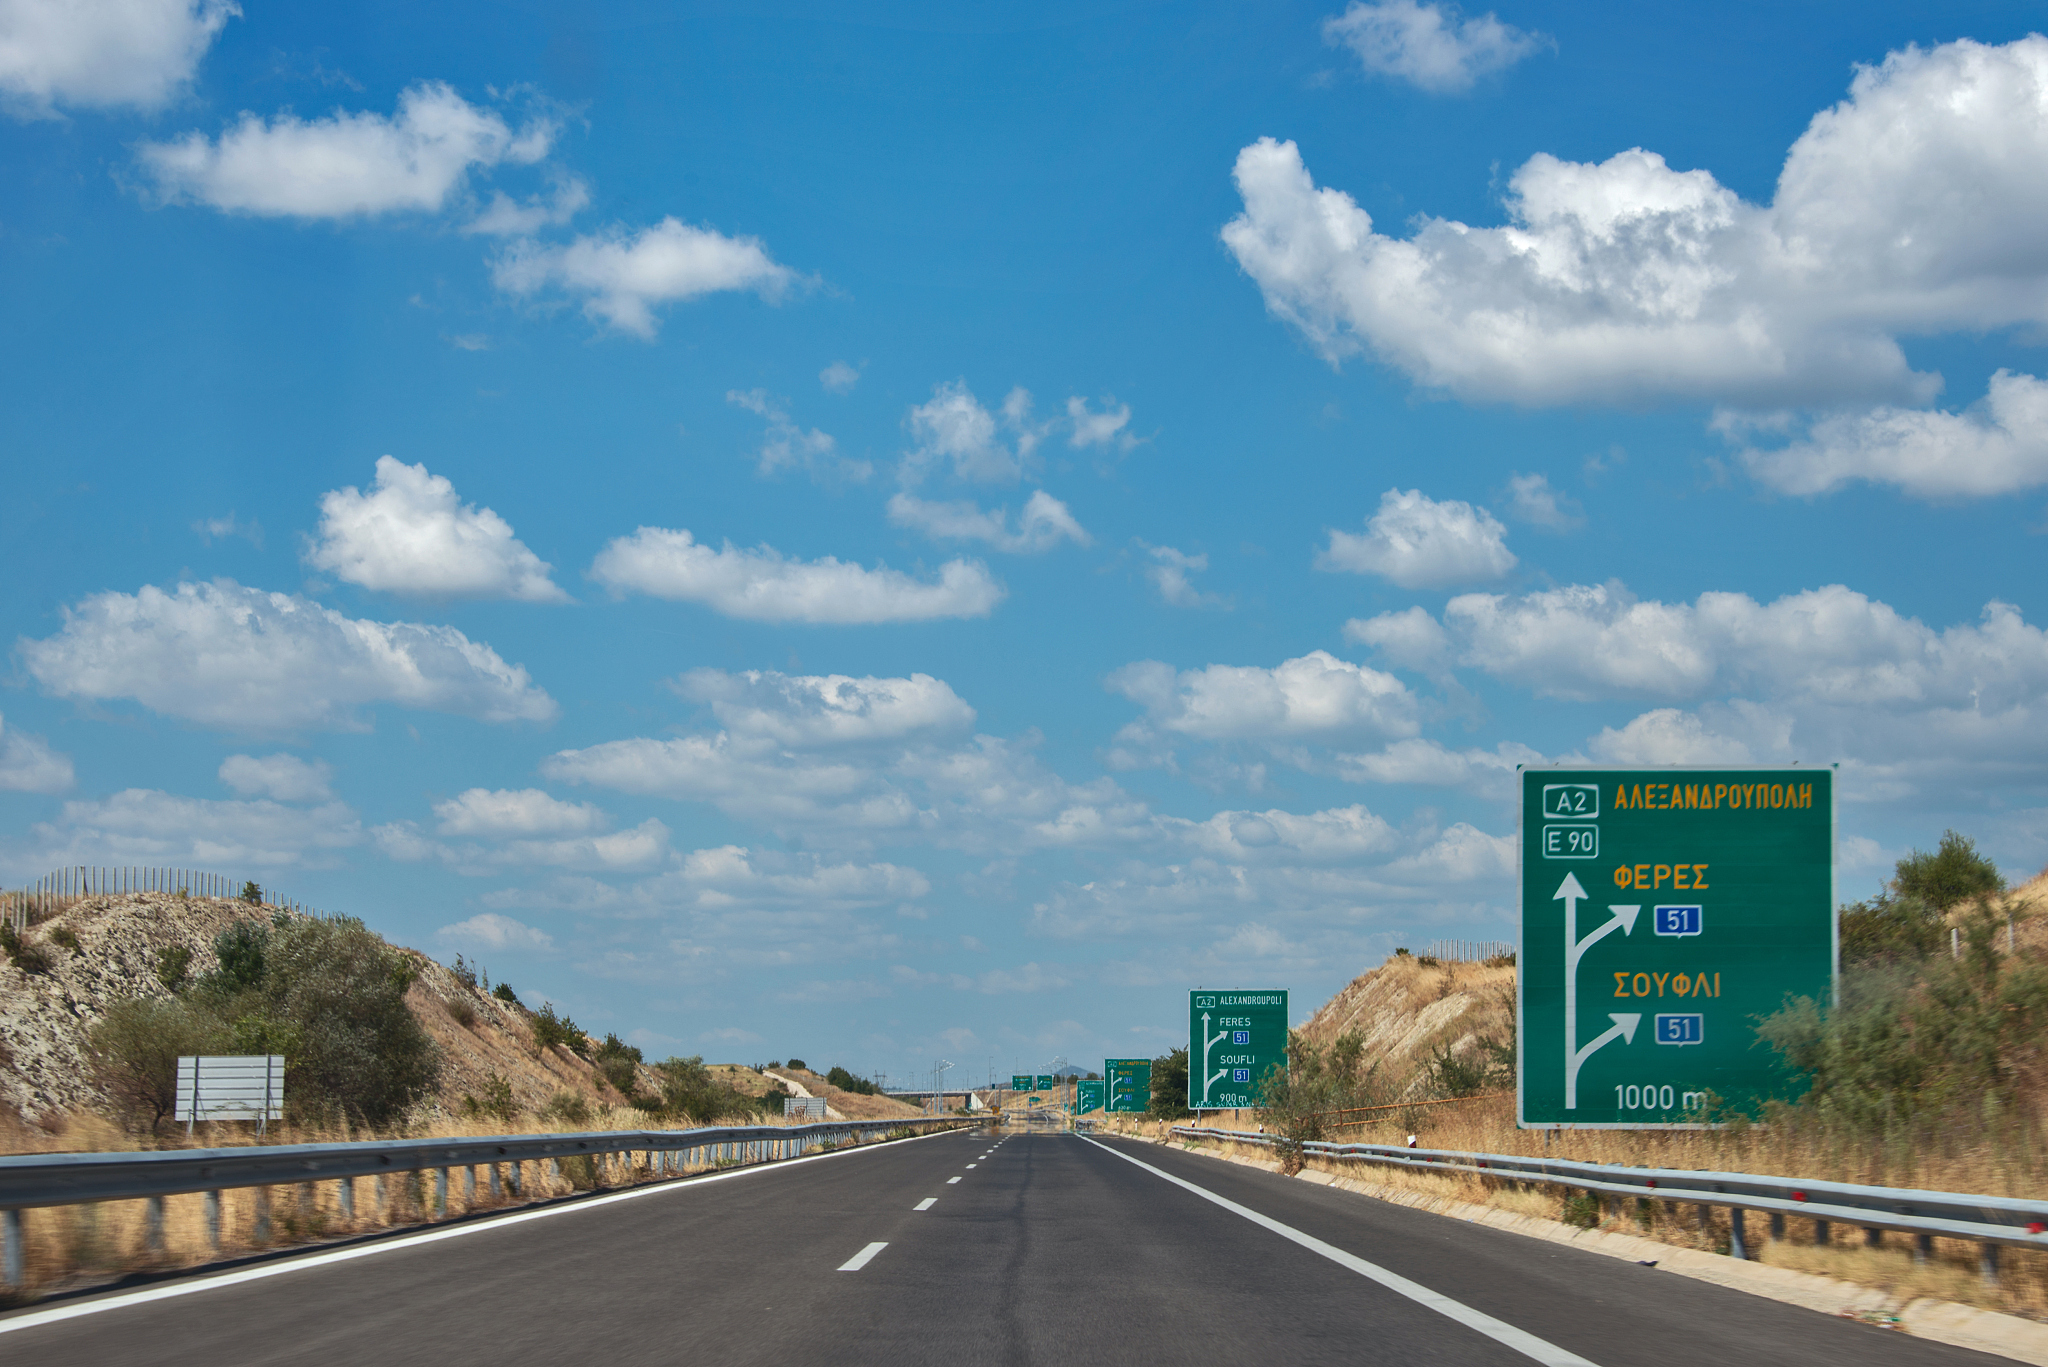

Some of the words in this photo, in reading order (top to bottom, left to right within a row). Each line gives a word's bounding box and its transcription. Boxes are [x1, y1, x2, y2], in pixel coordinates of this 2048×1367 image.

[1556, 791, 1587, 812] A2
[1614, 783, 1813, 810] ΑΛΕΞΑΝΔΡΟΥΠΟΛΗ
[1548, 831, 1561, 852] E
[1568, 831, 1593, 852] 90
[1613, 864, 1709, 890] ΦΕΡΕΣ
[1667, 909, 1689, 931] 51
[1613, 972, 1721, 998] ΣΟΥΦΛΙ
[1200, 998, 1212, 1006] A2
[1220, 995, 1282, 1005] ALEXANDROUPOLI
[1220, 1017, 1251, 1027] FERES
[1667, 1018, 1691, 1040] 51
[1236, 1033, 1246, 1042] 51
[1220, 1055, 1255, 1065] SOUFLI
[1236, 1071, 1246, 1080] 51
[1220, 1093, 1237, 1102] 900
[1614, 1084, 1674, 1110] 1000
[1682, 1090, 1708, 1110] m
